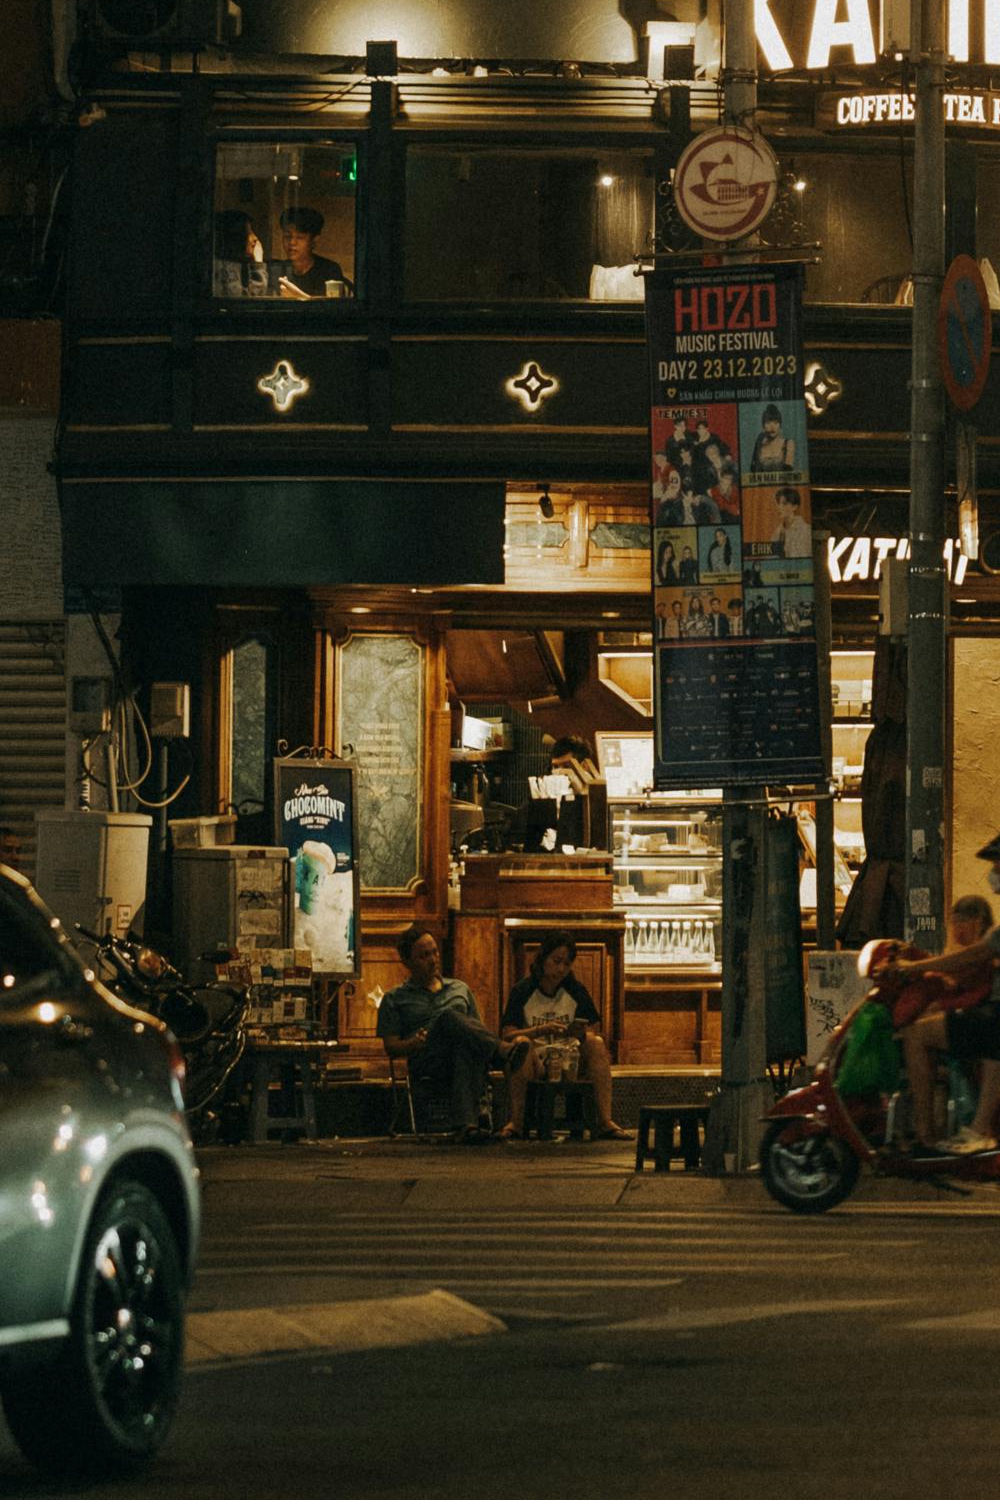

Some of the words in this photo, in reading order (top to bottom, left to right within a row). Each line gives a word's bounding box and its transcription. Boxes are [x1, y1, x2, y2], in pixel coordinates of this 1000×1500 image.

[943, 94, 986, 124] TEA
[674, 283, 777, 333] HOZO
[675, 334, 716, 354] MUSIC
[719, 330, 778, 351] FESTIVAL
[703, 355, 797, 379] 23.12.2023
[658, 408, 708, 420] TEMPEST
[752, 543, 774, 556] ERIK
[284, 796, 345, 822] CHOCOMINT
